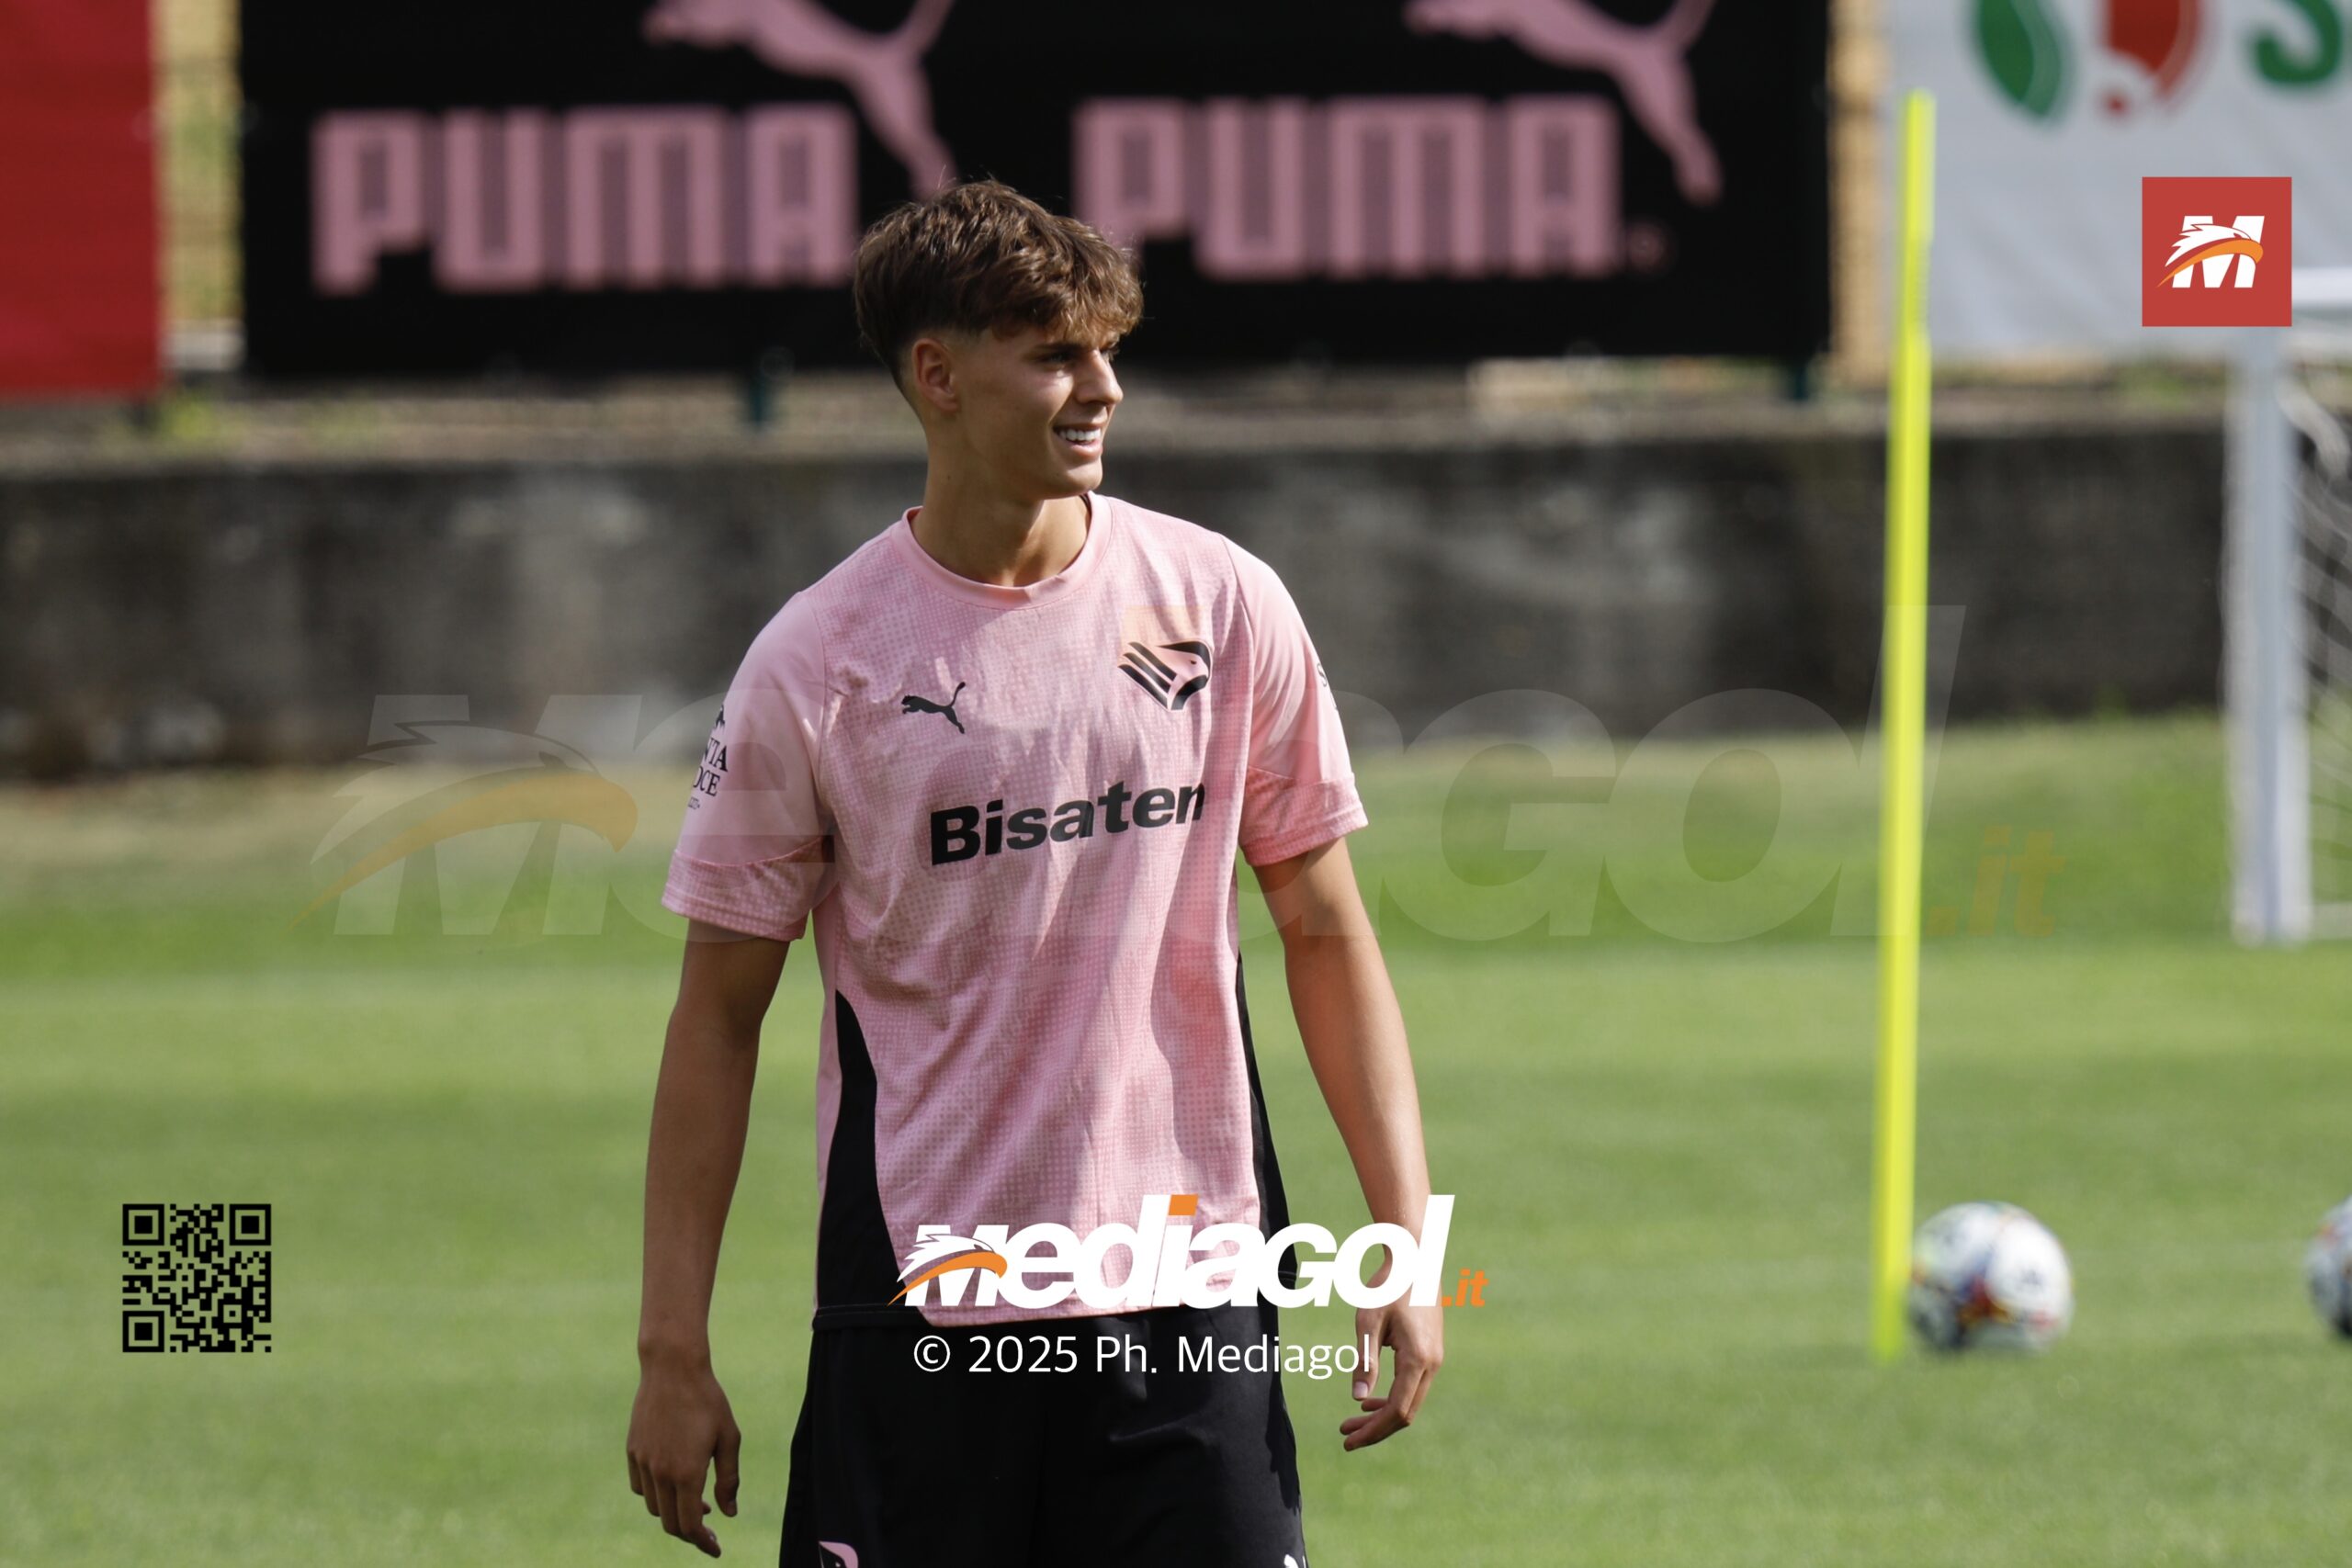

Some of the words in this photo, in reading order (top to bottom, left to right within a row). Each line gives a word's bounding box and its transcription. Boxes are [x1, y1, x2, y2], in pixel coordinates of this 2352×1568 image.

[310, 103, 861, 297] PUMA
[1072, 96, 1622, 279] PUMA
[930, 781, 1205, 865] Bisaten
